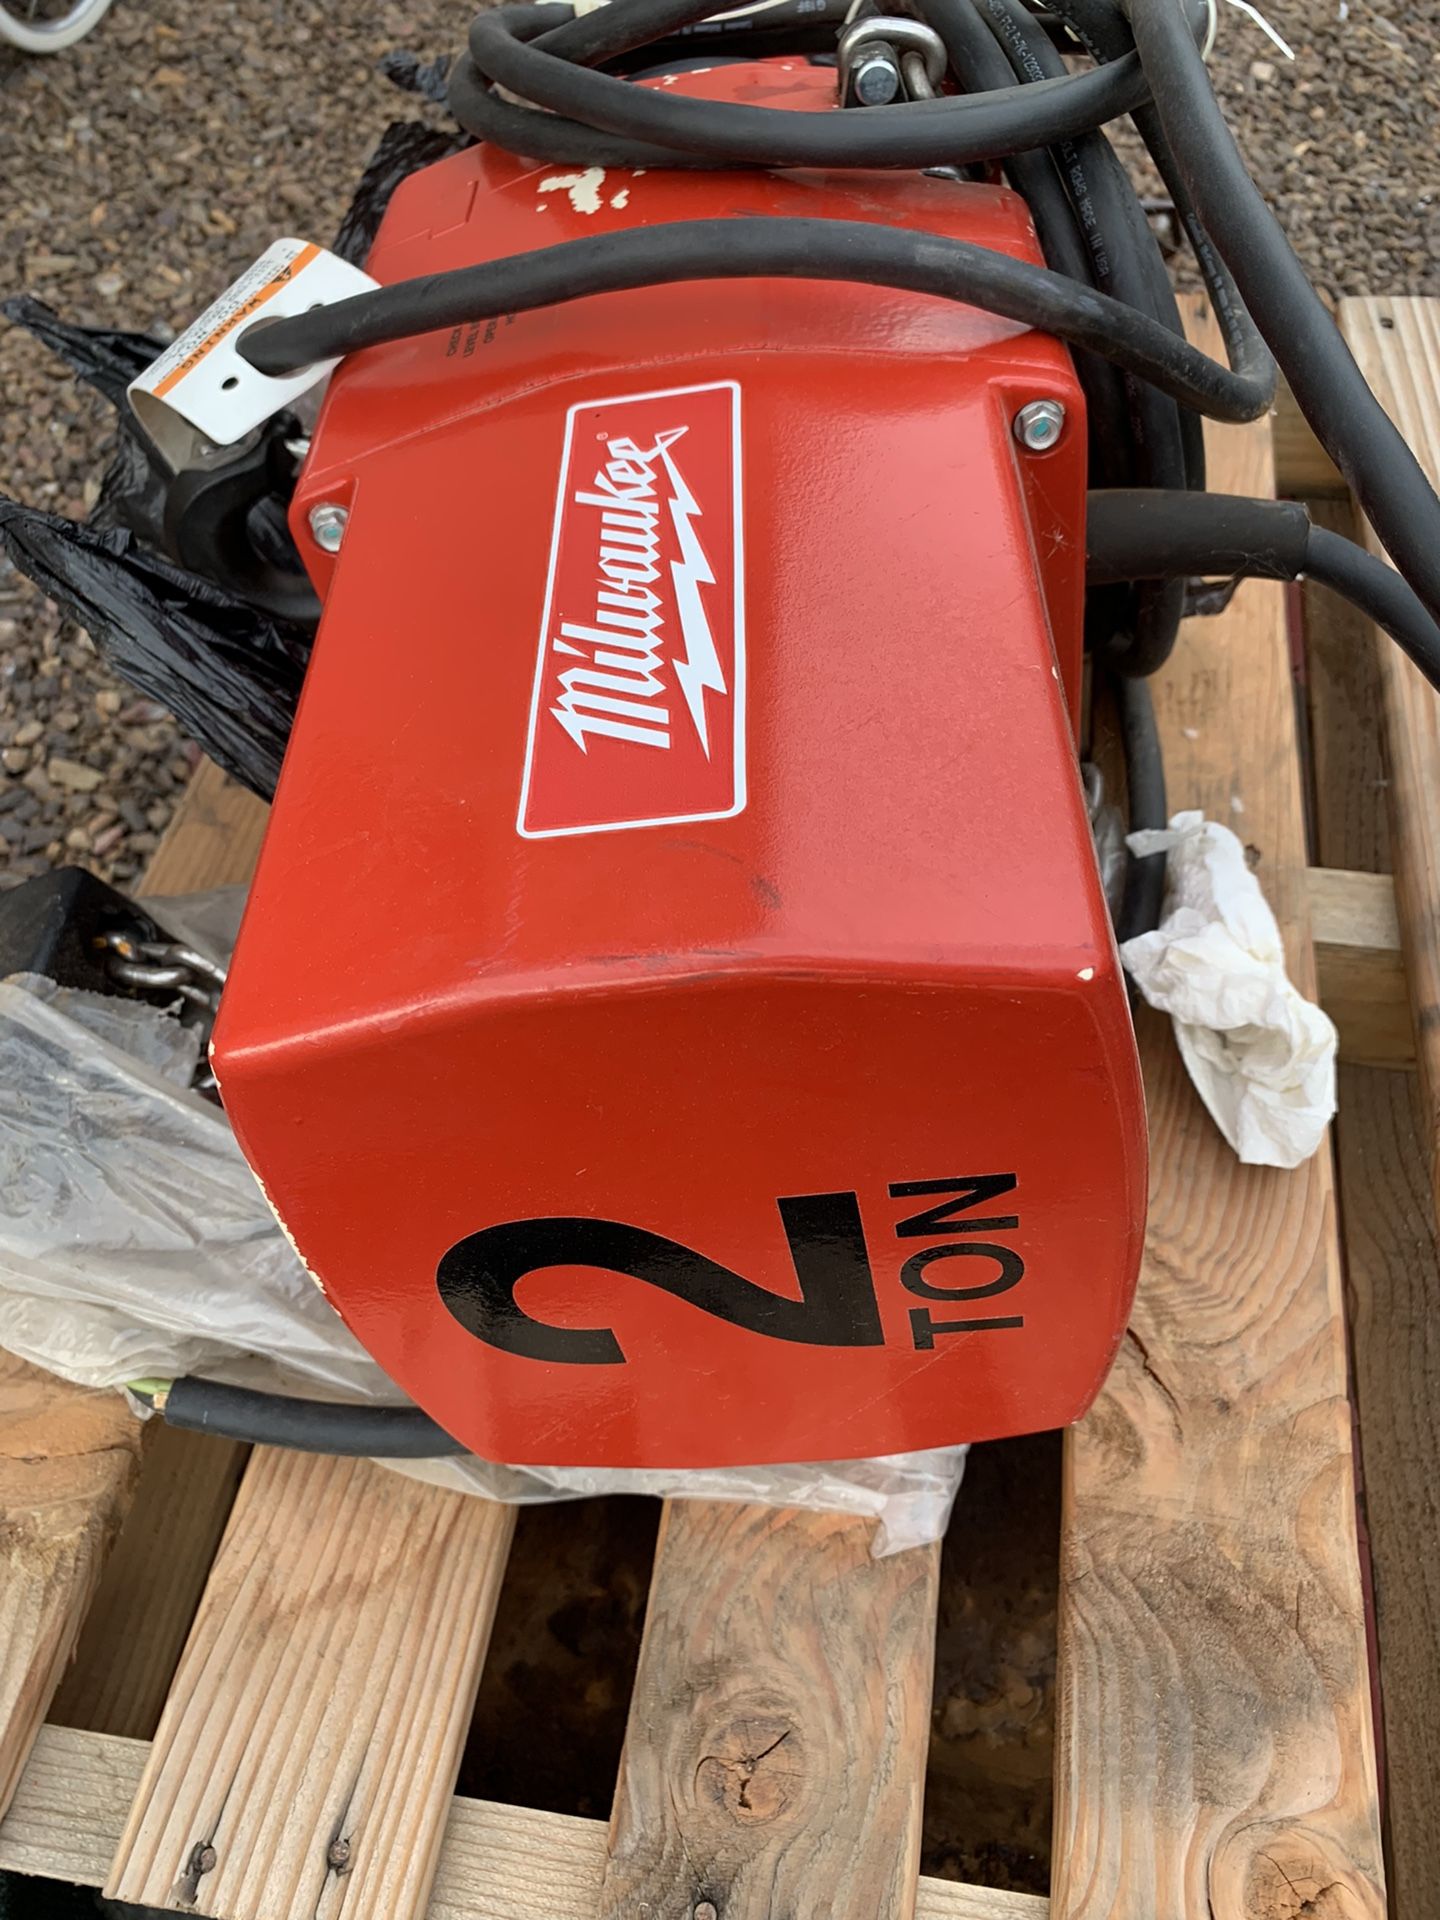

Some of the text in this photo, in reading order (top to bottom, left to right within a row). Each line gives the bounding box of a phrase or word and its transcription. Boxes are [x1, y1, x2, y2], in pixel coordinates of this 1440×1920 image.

[180, 297, 263, 371] WARNING
[548, 426, 689, 756] Milwaukee
[436, 1190, 885, 1365] 2
[886, 1172, 1024, 1351] TON
